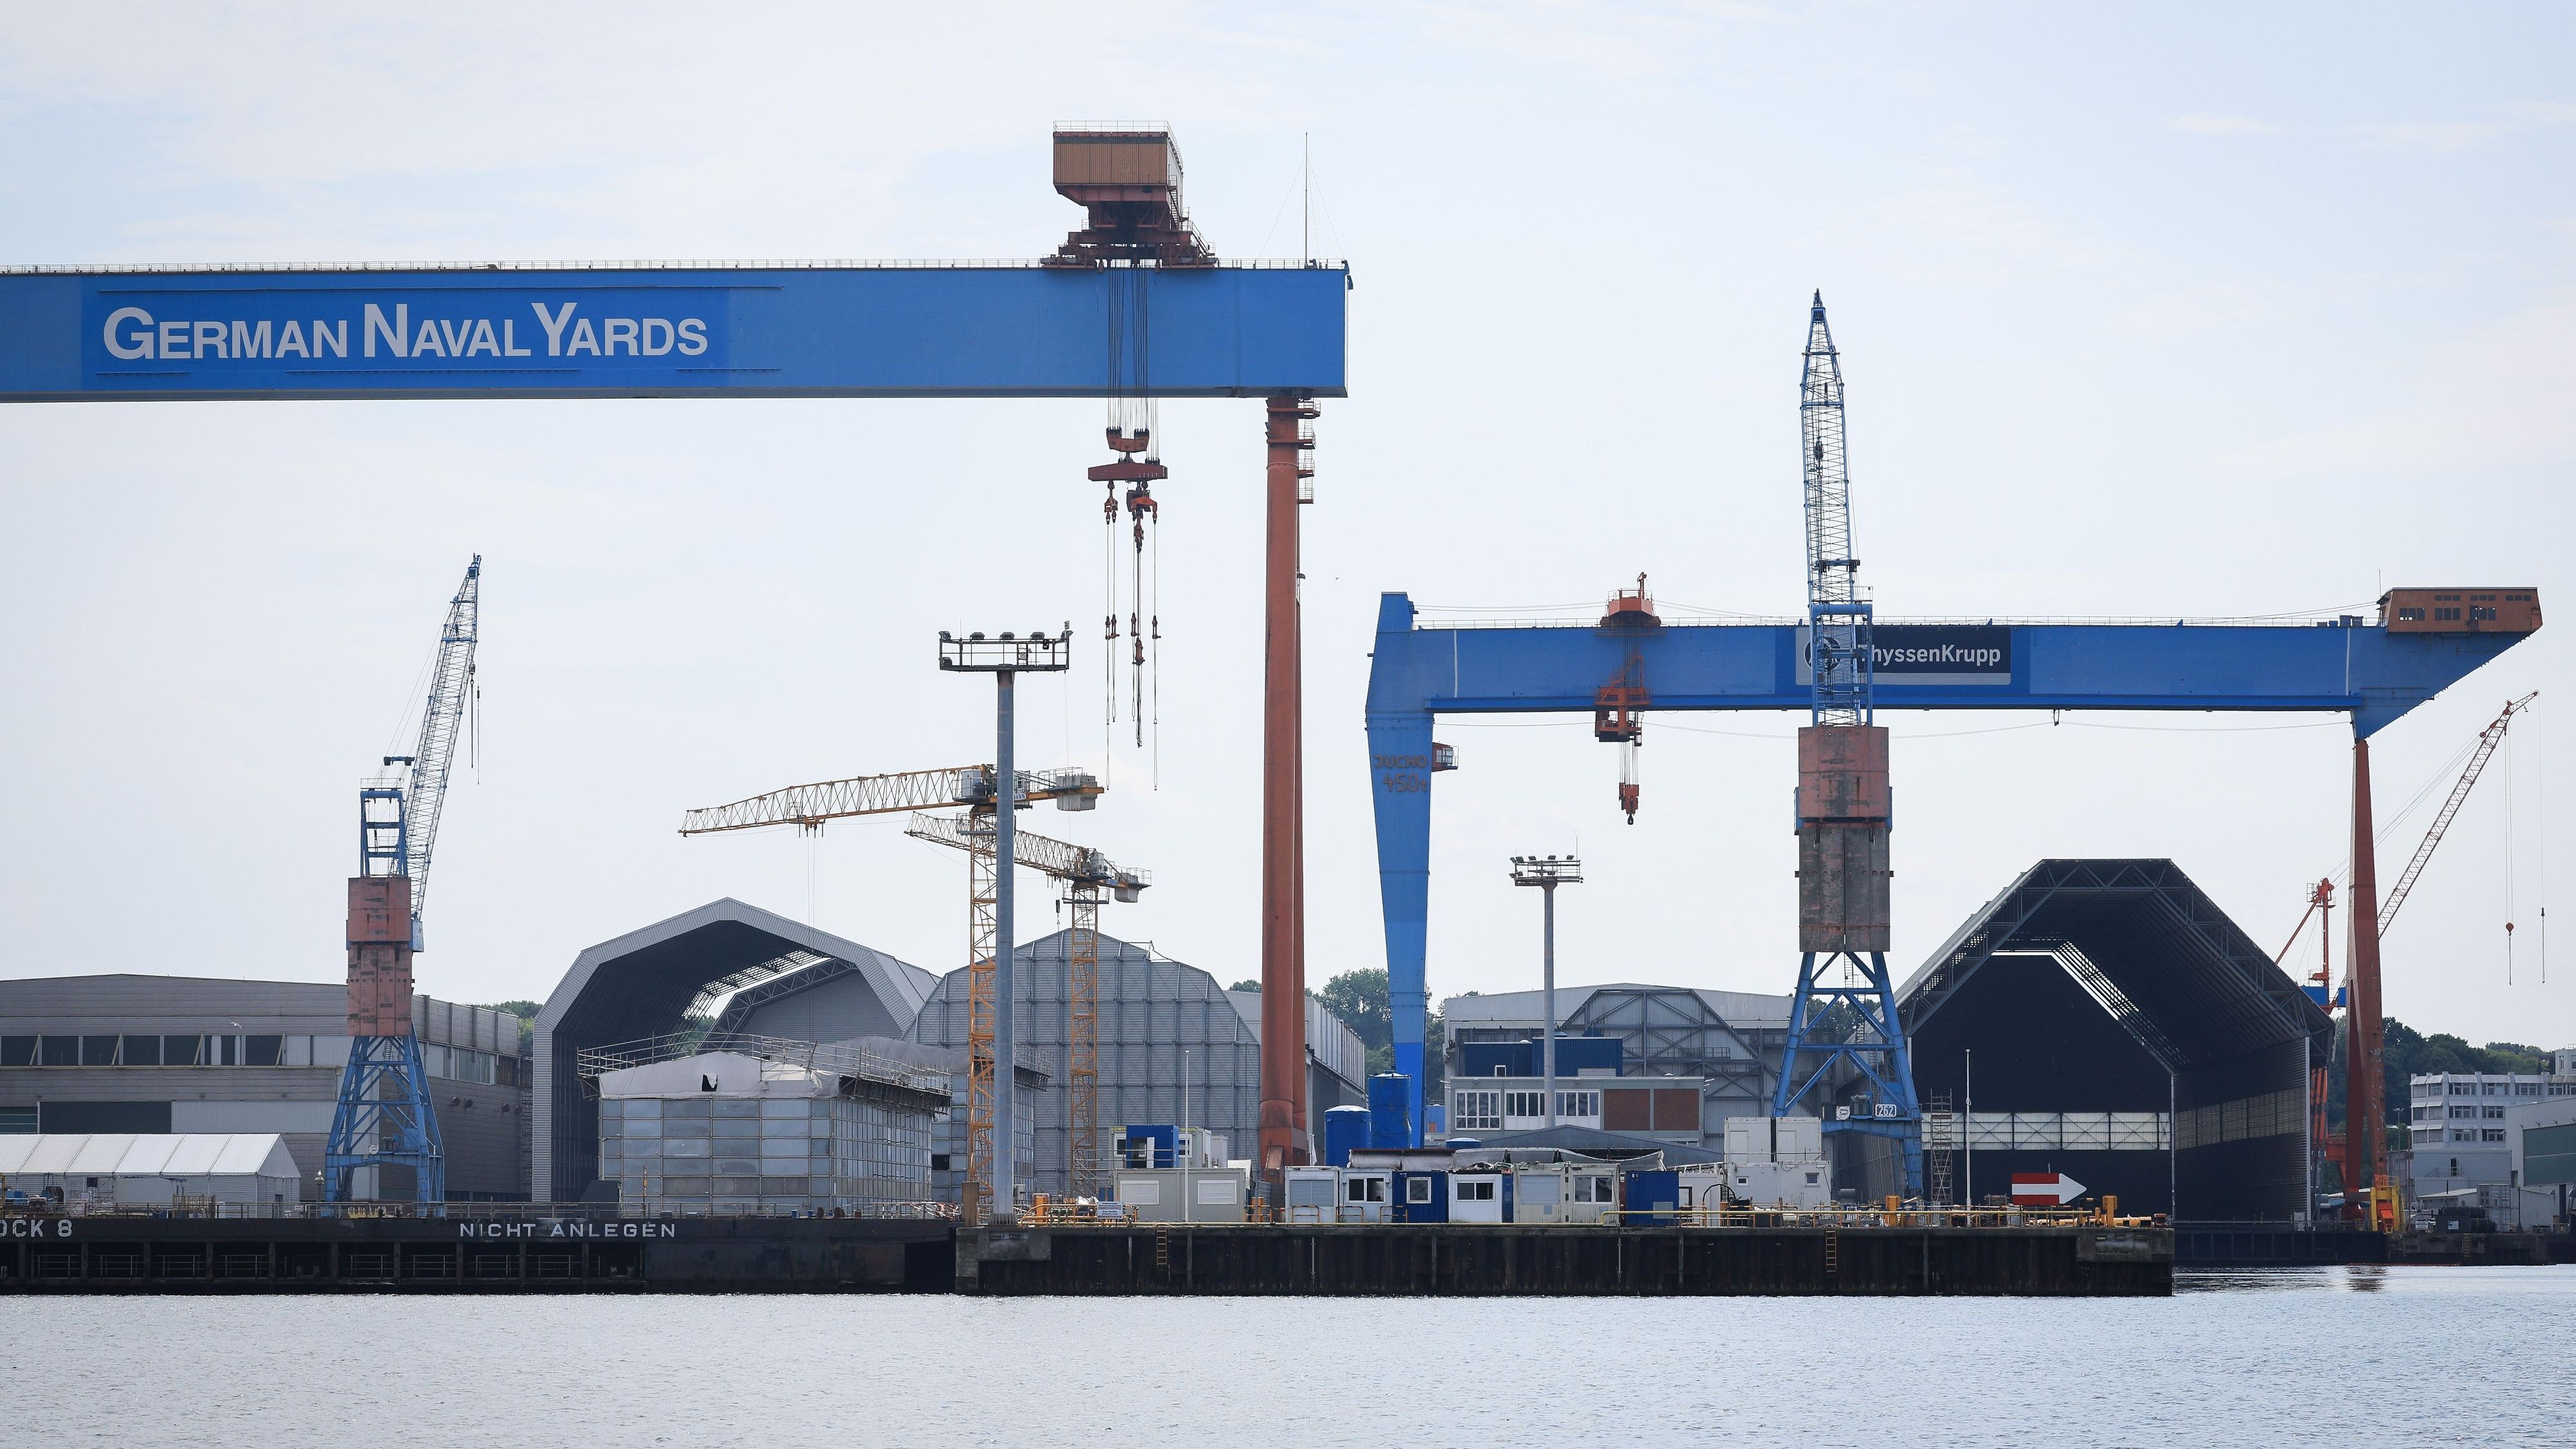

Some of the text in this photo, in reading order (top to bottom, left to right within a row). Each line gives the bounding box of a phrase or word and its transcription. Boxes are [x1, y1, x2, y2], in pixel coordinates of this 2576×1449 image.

[104, 303, 708, 359] GERMAN NAVAL YARDS
[1374, 754, 1427, 768] JUCHO
[1879, 1106, 1893, 1115] 262
[58, 1219, 72, 1237] 8
[460, 1224, 675, 1237] NICHT ANLEGEN
